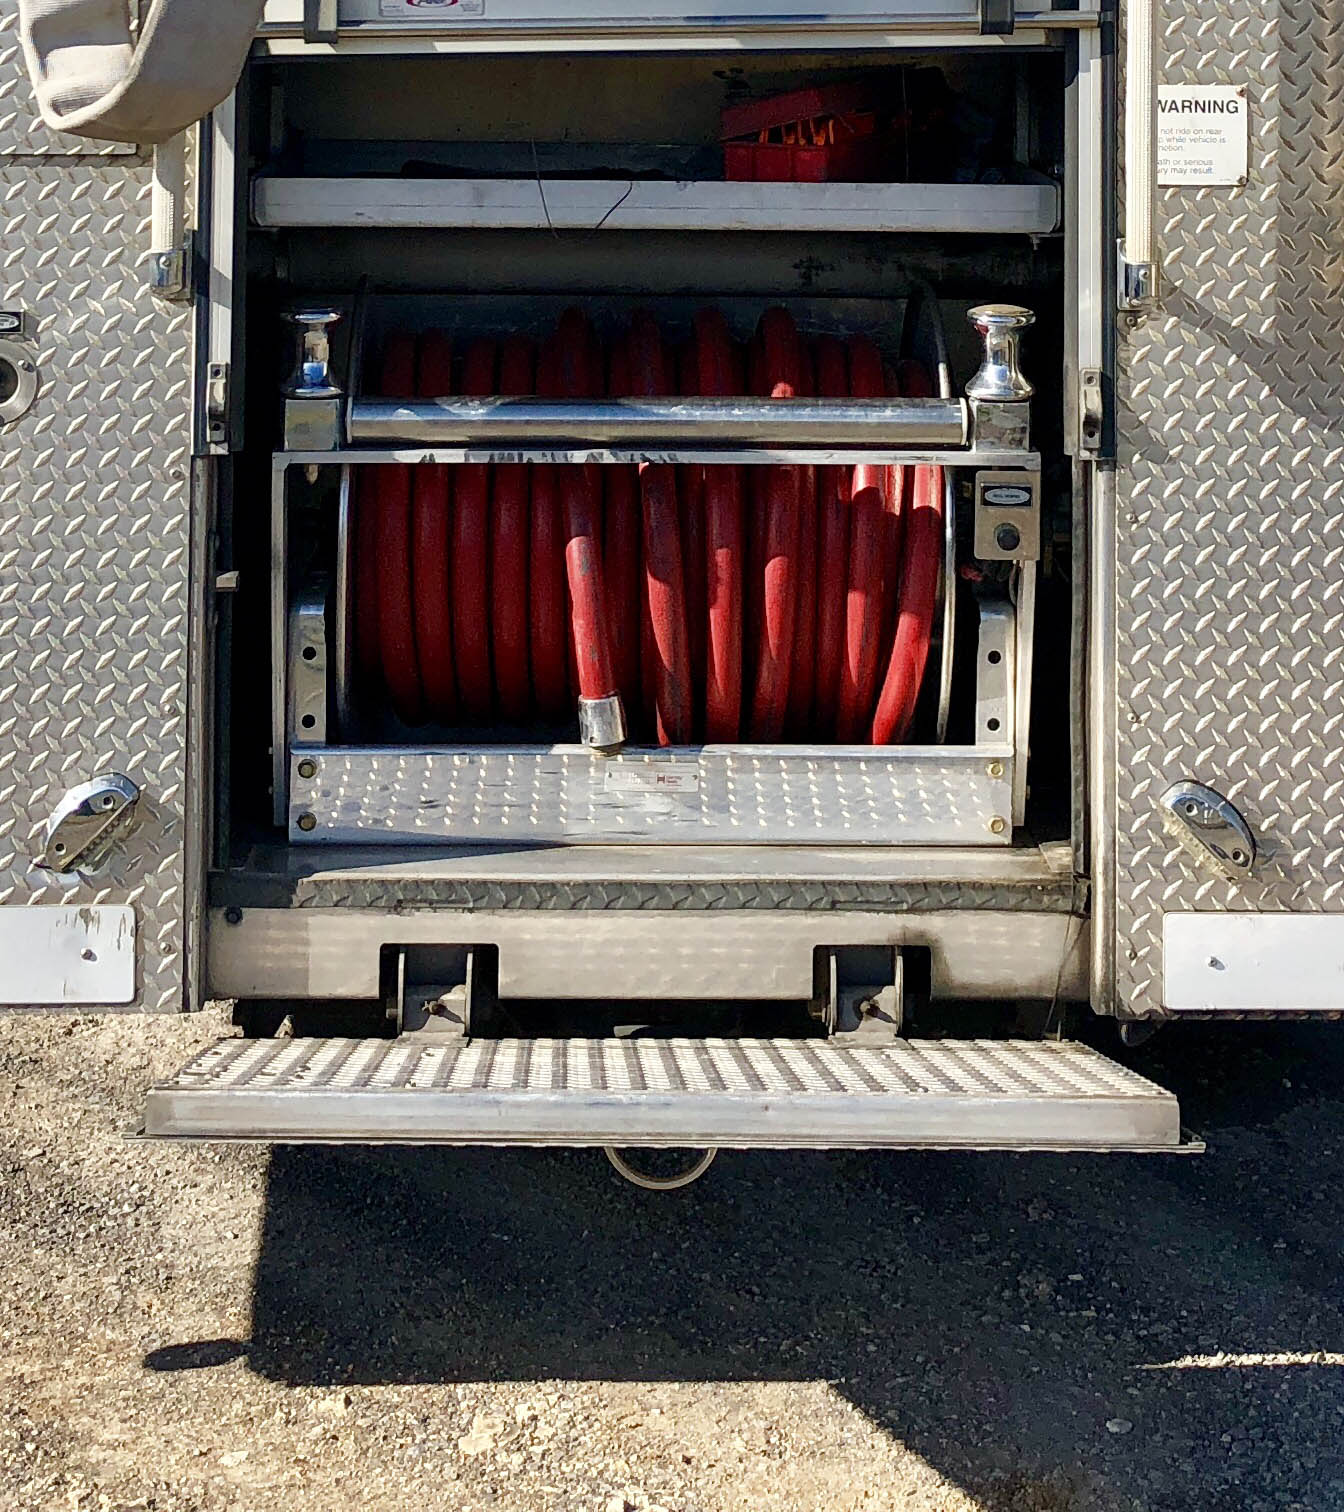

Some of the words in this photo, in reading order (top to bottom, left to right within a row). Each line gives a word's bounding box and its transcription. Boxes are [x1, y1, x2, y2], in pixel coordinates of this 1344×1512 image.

[1160, 127, 1173, 135] not
[1175, 127, 1191, 135] ride
[1166, 135, 1186, 144] while
[1189, 135, 1217, 144] vehicle
[1219, 136, 1226, 144] is
[1183, 158, 1213, 166] serious
[1170, 168, 1187, 176] may
